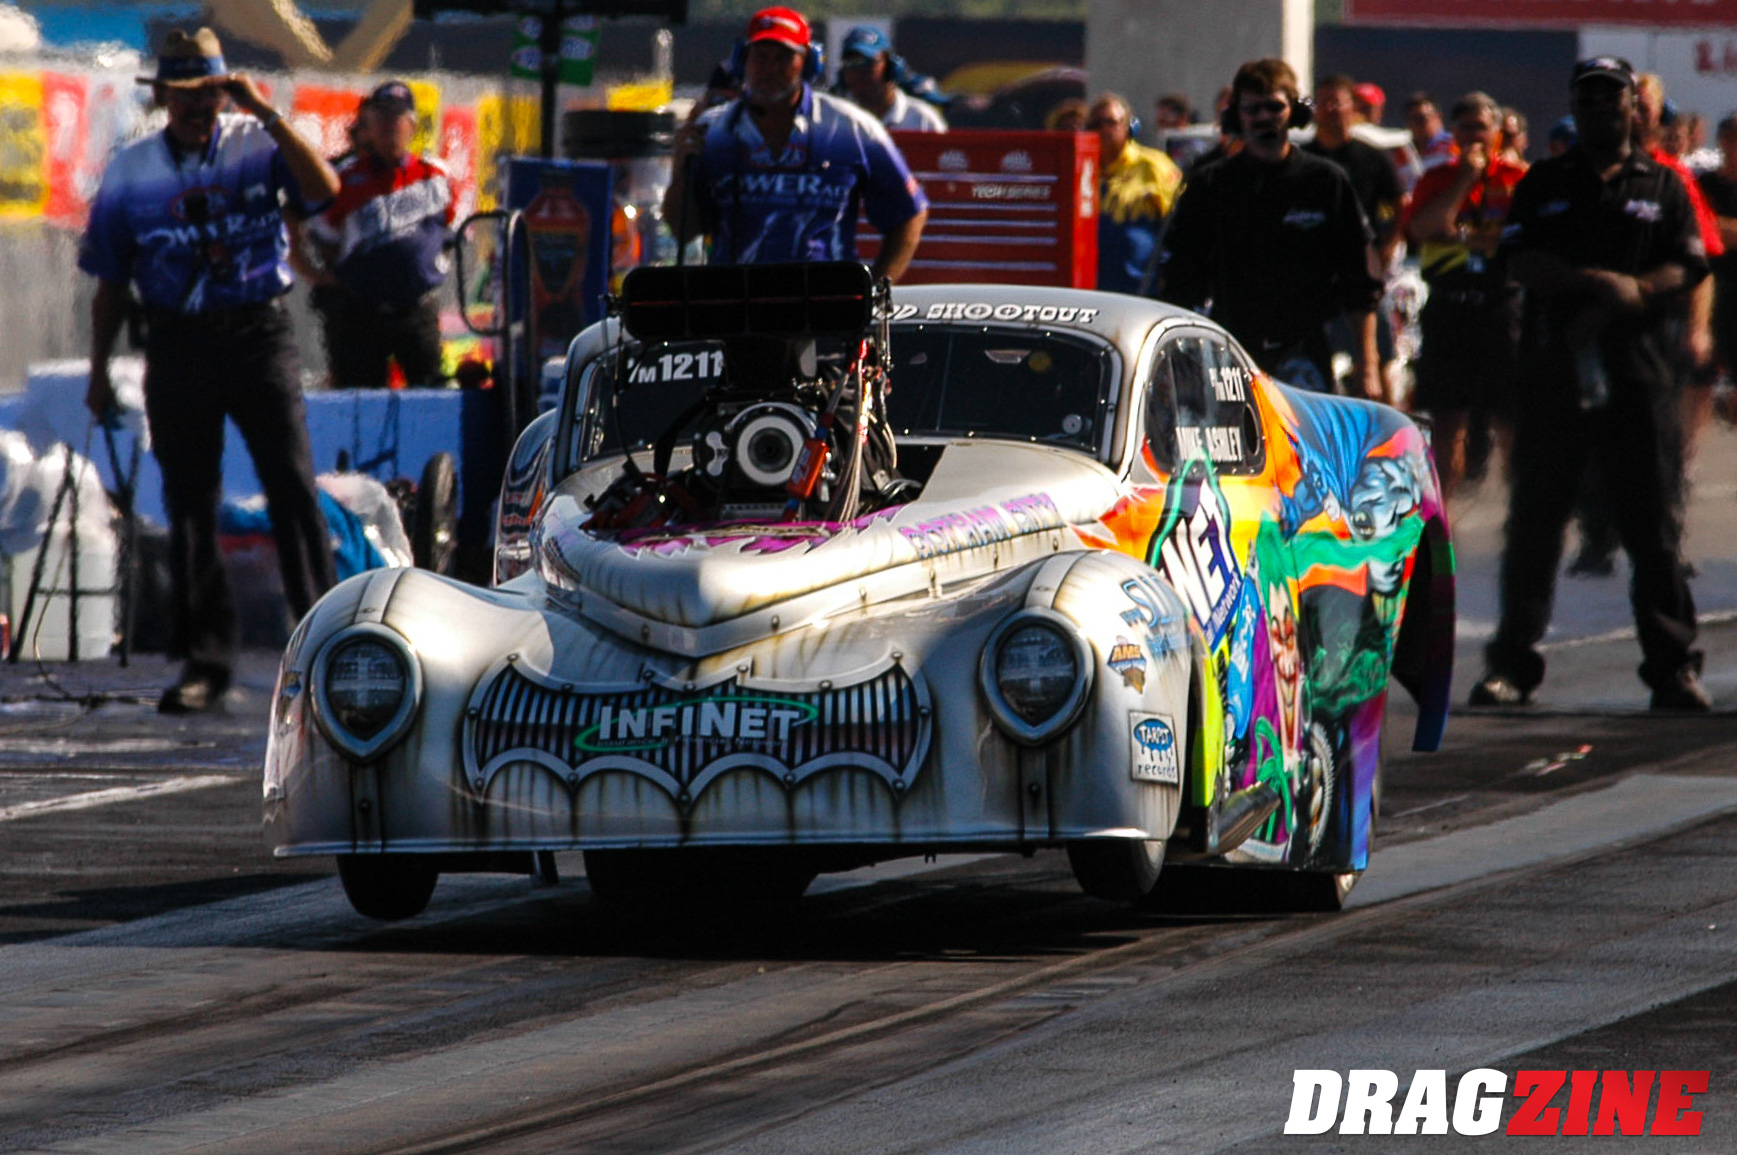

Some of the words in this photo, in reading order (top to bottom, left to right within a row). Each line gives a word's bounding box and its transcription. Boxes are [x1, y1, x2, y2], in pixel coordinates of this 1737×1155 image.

[926, 303, 1098, 323] SHOOTOUT
[658, 349, 724, 382] 1211
[1220, 366, 1245, 402] 1211
[600, 702, 800, 740] INFINET
[1137, 763, 1176, 779] records
